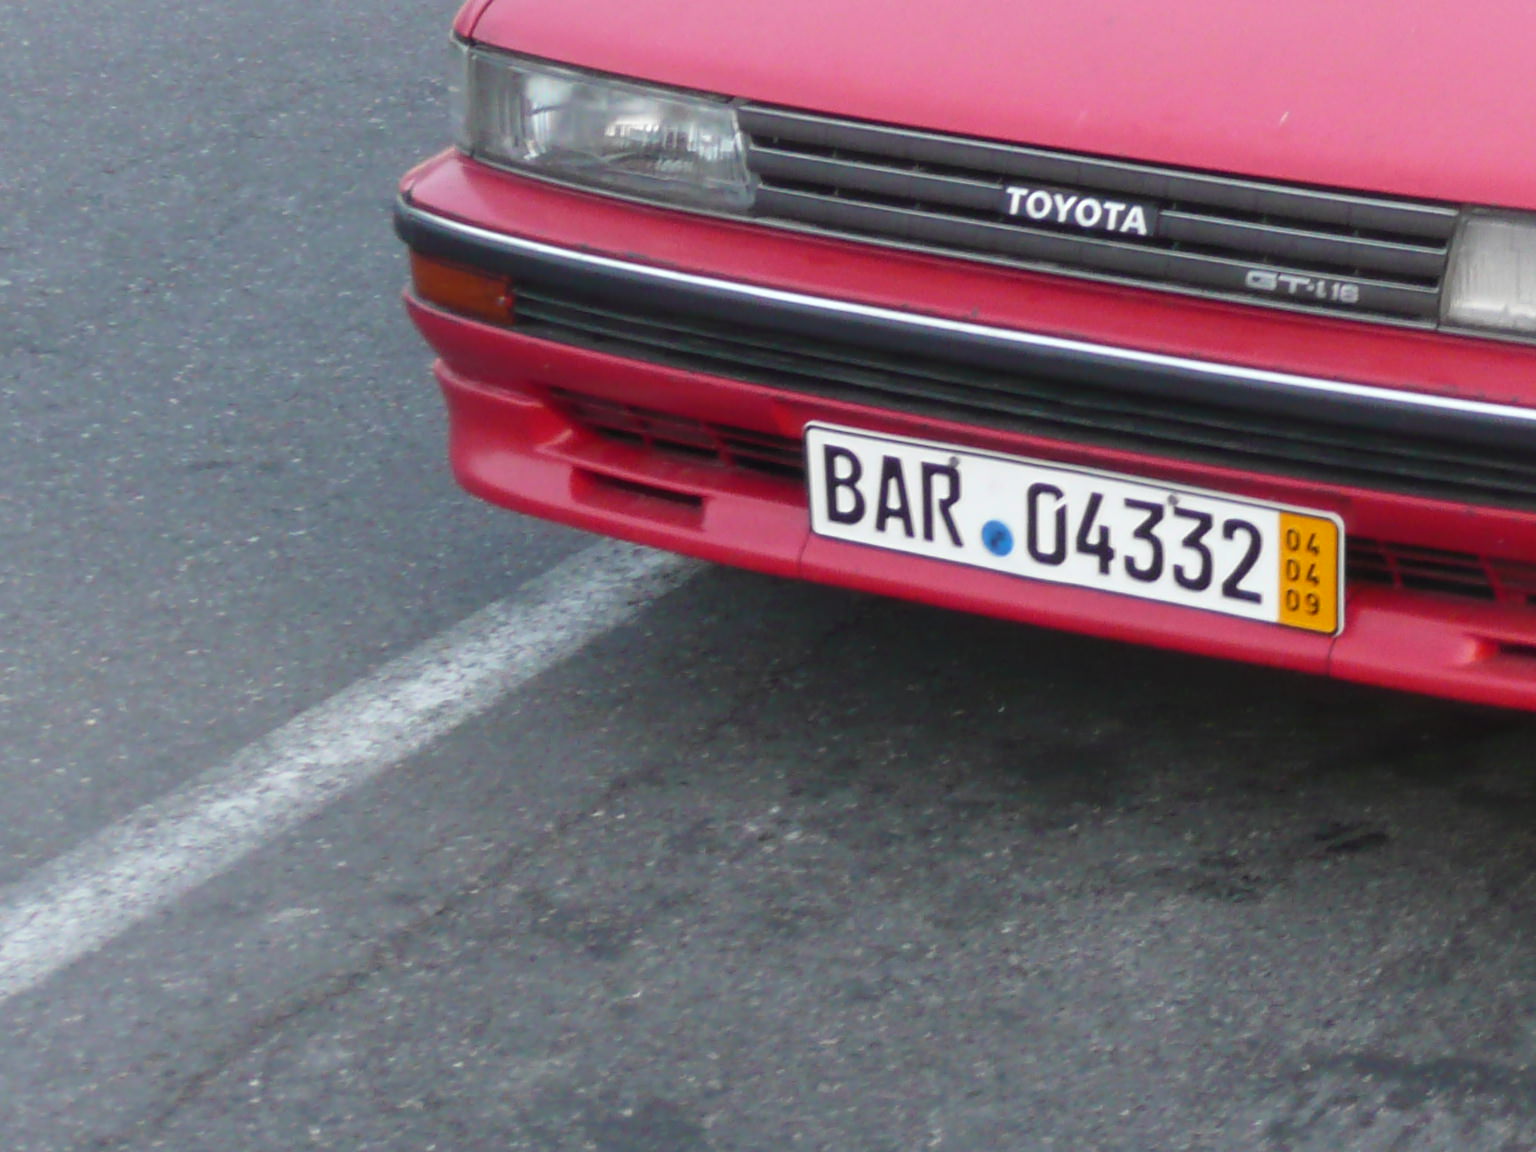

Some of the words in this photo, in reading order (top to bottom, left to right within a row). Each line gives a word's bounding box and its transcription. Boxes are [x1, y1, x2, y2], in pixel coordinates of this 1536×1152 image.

[1006, 186, 1148, 236] TOYOTA
[823, 444, 963, 548] BAR
[1026, 482, 1263, 604] 04332
[1285, 528, 1320, 556] 04
[1285, 558, 1320, 586] 04
[1285, 588, 1320, 616] 09
